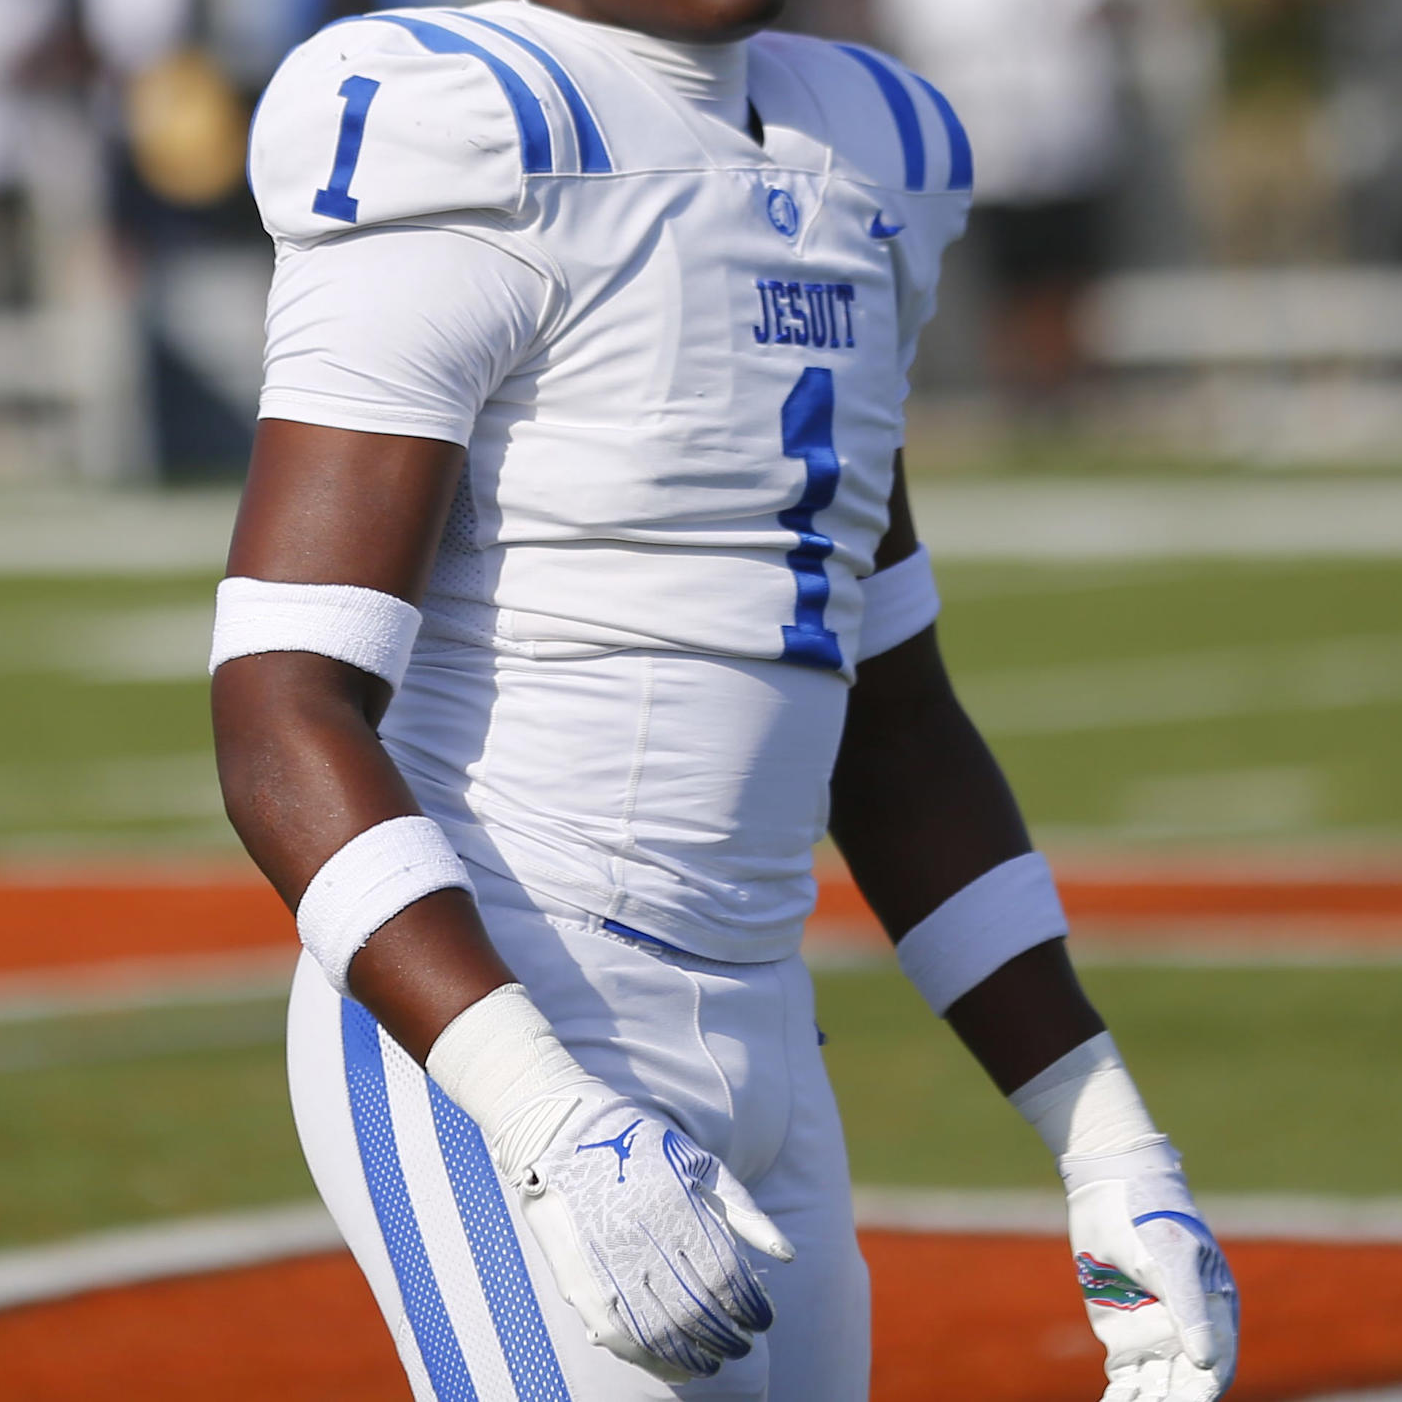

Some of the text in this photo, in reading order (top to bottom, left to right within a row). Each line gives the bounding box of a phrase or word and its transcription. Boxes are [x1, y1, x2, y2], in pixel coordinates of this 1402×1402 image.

[312, 76, 380, 223] 1
[753, 279, 856, 349] JESUIT
[777, 367, 845, 671] 1
